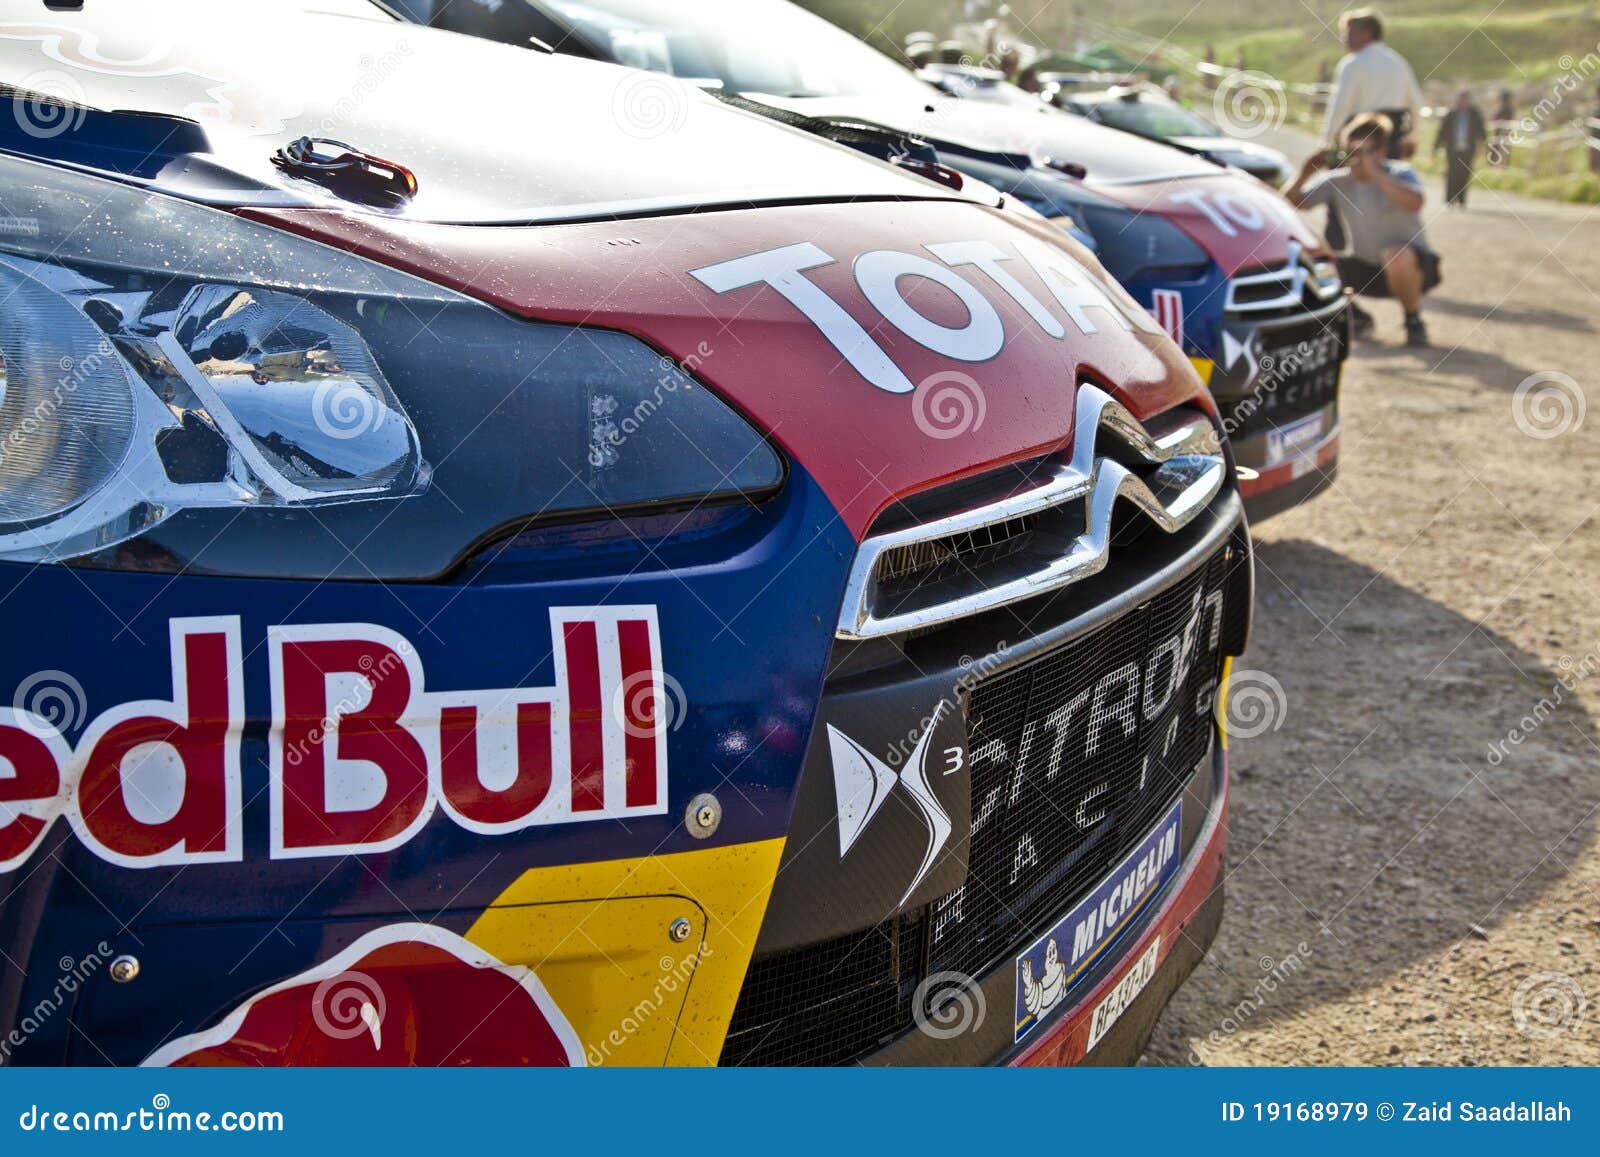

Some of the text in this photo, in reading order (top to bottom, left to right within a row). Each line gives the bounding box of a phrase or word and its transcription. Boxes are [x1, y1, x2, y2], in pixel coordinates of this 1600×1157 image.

[0, 612, 662, 866] ed Bull
[943, 747, 964, 775] 3
[1072, 822, 1178, 966] MICHELIN
